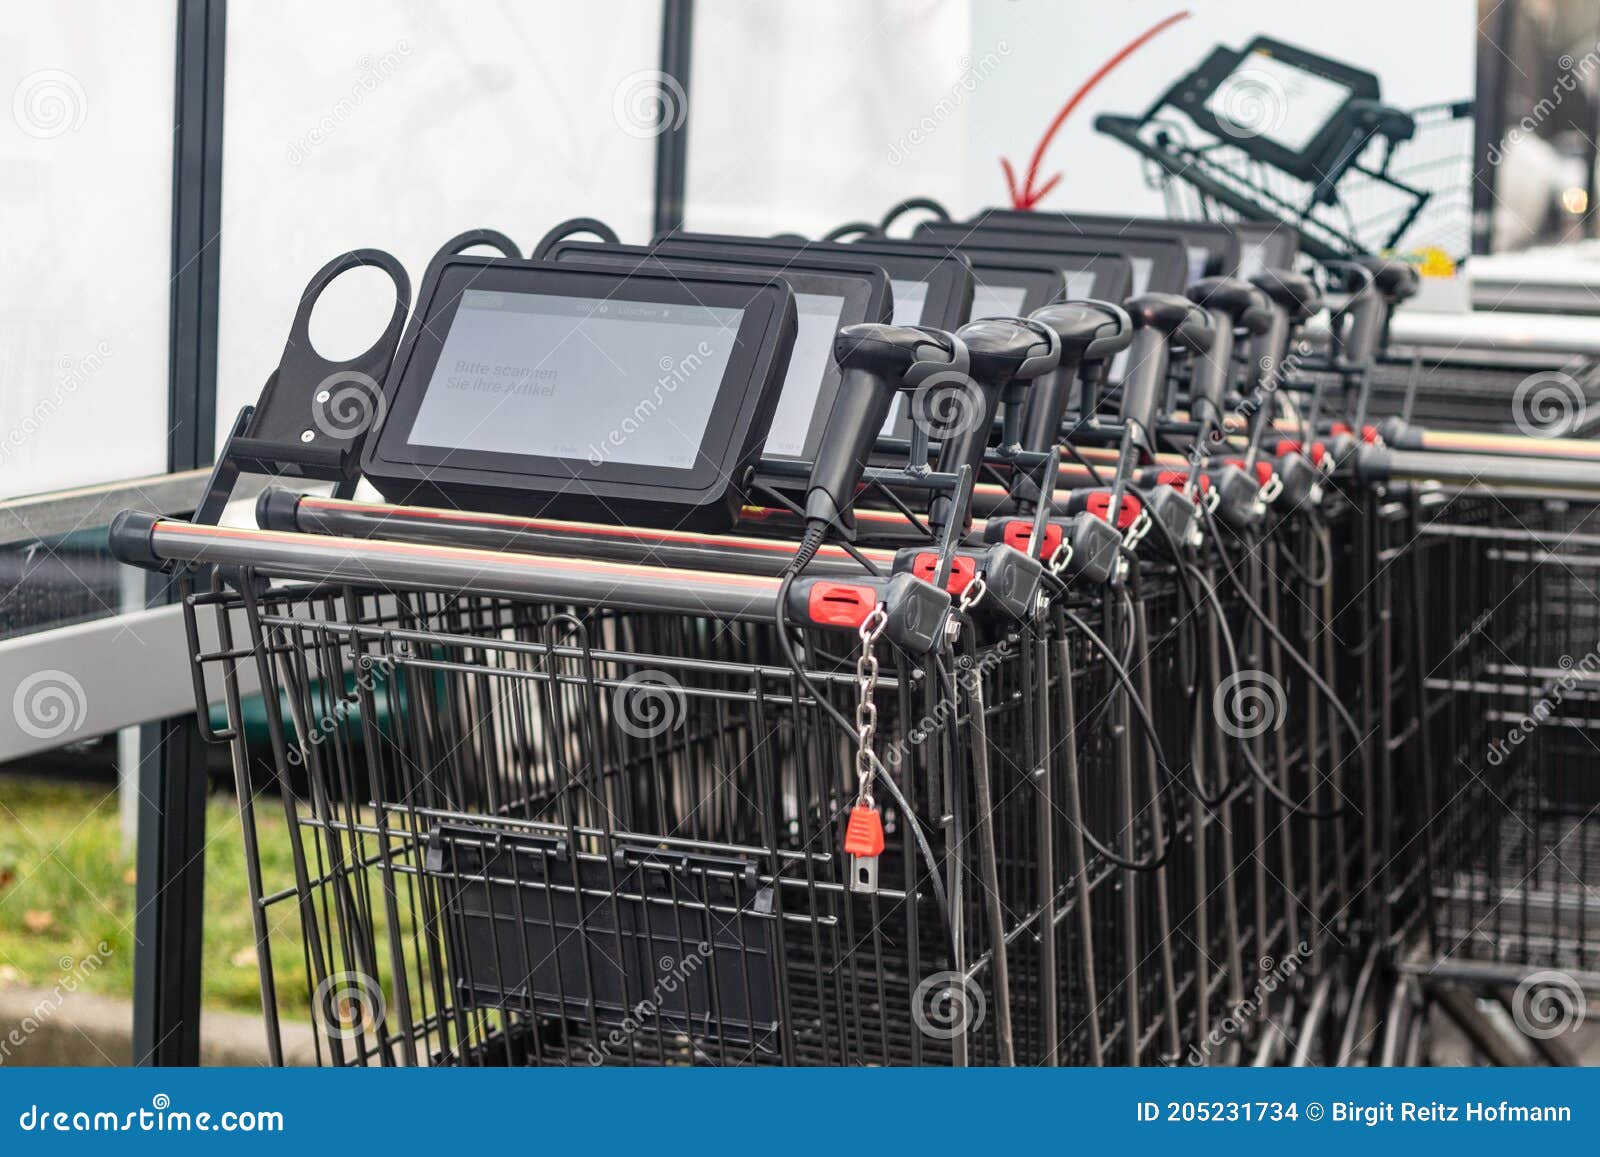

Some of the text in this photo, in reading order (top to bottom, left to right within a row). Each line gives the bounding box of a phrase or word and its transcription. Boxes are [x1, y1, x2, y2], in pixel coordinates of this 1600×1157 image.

[455, 360, 559, 380] Bitte scannen
[446, 377, 472, 391] Sie
